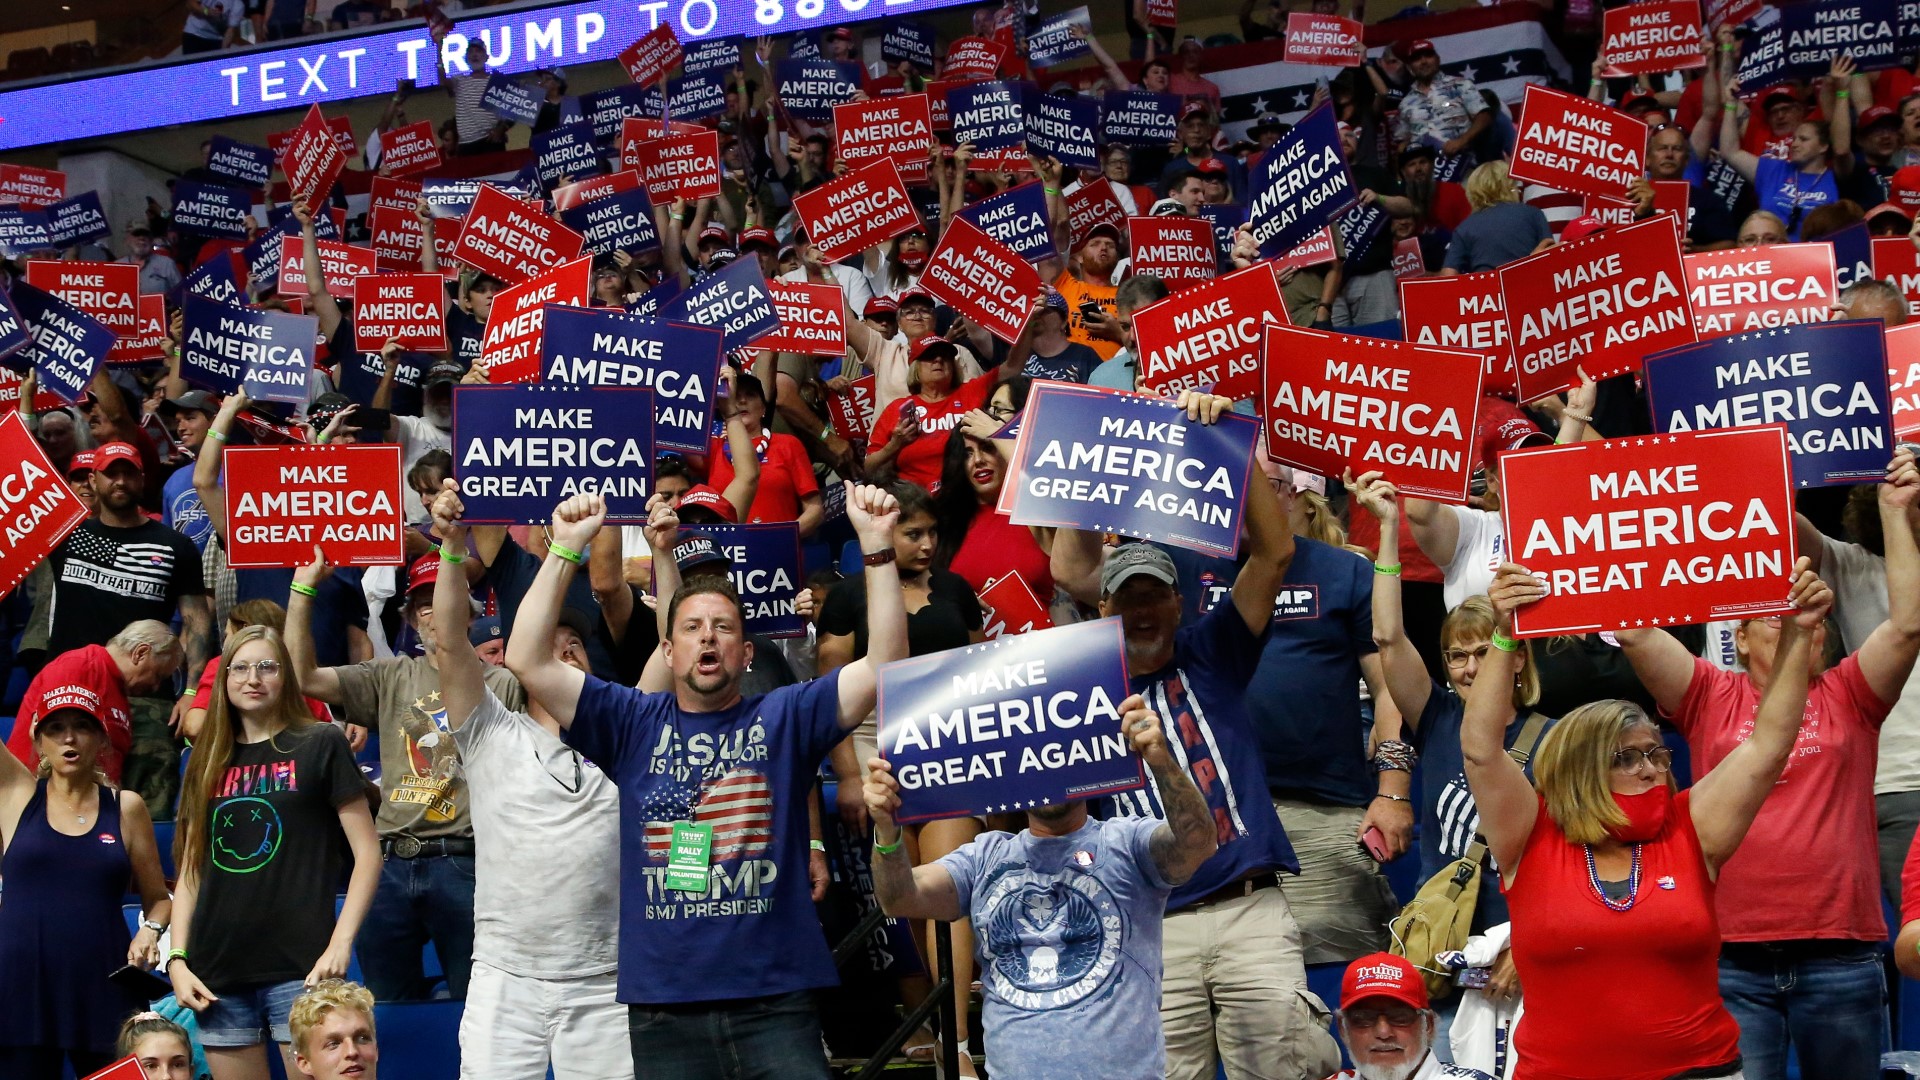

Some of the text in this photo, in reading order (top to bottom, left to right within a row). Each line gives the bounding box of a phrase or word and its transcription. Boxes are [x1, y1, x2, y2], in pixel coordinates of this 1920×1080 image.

[1311, 22, 1340, 32] MAKE
[1630, 11, 1671, 26] MAKE
[1815, 7, 1861, 24] MAKE
[636, 37, 659, 55] MAKE
[701, 40, 725, 50] MAKE
[1606, 24, 1699, 50] AMERICA
[221, 48, 366, 106] TEXT
[397, 12, 605, 79] TRUMP
[639, 1, 717, 36] TO
[684, 45, 739, 64] AMERICA
[802, 68, 836, 79] MAKE
[780, 80, 856, 96] AMERICA
[972, 91, 1010, 106] MAKE
[862, 108, 900, 123] MAKE
[1040, 104, 1071, 121] MAKE
[1128, 100, 1158, 110] MAKE
[1026, 114, 1094, 144] AMERICA
[1107, 110, 1176, 126] AMERICA
[1562, 110, 1612, 136] MAKE
[396, 132, 416, 144] MAKE
[549, 134, 574, 148] MAKE
[841, 120, 928, 145] AMERICA
[1027, 132, 1055, 153] GREAT
[386, 138, 434, 160] AMERICA
[659, 144, 694, 159] MAKE
[842, 139, 929, 160] GREAT AGAIN
[1524, 122, 1639, 170] AMERICA
[646, 156, 716, 181] AMERICA
[1268, 138, 1306, 180] MAKE
[1520, 146, 1638, 187] GREAT AGAIN
[827, 181, 868, 207] MAKE
[1250, 146, 1341, 219] AMERICA
[177, 200, 246, 220] AMERICA
[198, 191, 228, 204] MAKE
[1255, 171, 1348, 245] GREAT AGAIN
[587, 203, 622, 223] MAKE
[812, 186, 902, 238] AMERICA
[979, 203, 1016, 226] MAKE
[506, 211, 550, 240] MAKE
[817, 204, 910, 252] GREAT AGAIN
[1158, 229, 1192, 240] MAKE
[464, 235, 516, 266] GREAT
[973, 246, 1015, 278] MAKE
[1136, 244, 1214, 262] AMERICA
[61, 274, 104, 287] MAKE
[938, 246, 1028, 313] AMERICA
[1554, 254, 1622, 293] MAKE
[1697, 260, 1772, 280] MAKE
[379, 286, 414, 298] MAKE
[686, 281, 728, 311] MAKE
[768, 291, 810, 304] MAKE
[930, 266, 1021, 329] GREAT AGAIN
[358, 302, 440, 320] AMERICA
[724, 303, 772, 336] AGAIN
[1520, 271, 1679, 346] AMERICA
[1743, 306, 1829, 330] AGAIN
[220, 318, 273, 340] MAKE
[358, 324, 440, 338] GREAT AGAIN
[1522, 306, 1686, 374] GREAT AGAIN
[187, 326, 306, 368] AMERICA
[592, 333, 664, 360] MAKE
[187, 350, 240, 379] GREAT
[365, 353, 420, 379] TRMP
[1326, 359, 1410, 392] MAKE
[1716, 352, 1811, 388] MAKE
[547, 354, 705, 403] AMERICA
[516, 408, 592, 428] MAKE
[1273, 381, 1462, 440] AMERICA
[1668, 381, 1880, 432] AMERICA
[918, 413, 964, 433] UMP
[1100, 416, 1186, 446] MAKE
[1509, 428, 1531, 438] 2020
[463, 438, 645, 467] AMERICA
[1274, 419, 1461, 473] GREAT AGAIN
[1788, 426, 1884, 455] AGAIN
[280, 466, 347, 483] MAKE
[1034, 440, 1234, 499] AMERICA
[1589, 464, 1699, 500] MAKE
[462, 476, 646, 497] GREAT AGAIN
[5, 482, 66, 548] AGAIN
[236, 491, 394, 518] AMERICA
[1029, 477, 1232, 528] GREAT AGAIN
[235, 524, 395, 543] GREAT AGAIN
[1522, 498, 1780, 559] AMERICA
[673, 540, 712, 560] TRUMP
[62, 564, 166, 597] BUILD THAT WALL
[1534, 549, 1782, 598] GREAT AGAIN
[1209, 587, 1312, 605] TMP
[1720, 630, 1735, 666] AND
[953, 659, 1047, 698] MAKE
[43, 684, 100, 705] MAKE AMERICA
[47, 696, 95, 712] GREAT AGAIN
[894, 685, 1120, 755] AMERICA
[898, 733, 1126, 790] GREAT AGAIN
[1800, 746, 1821, 756] you
[649, 757, 692, 782] IS MY
[395, 790, 453, 814] DON'T RUN
[678, 846, 702, 856] RALLY
[642, 860, 778, 903] TUMP
[670, 871, 704, 880] VOLUNTEER
[646, 898, 774, 920] IS MY PRESIDENT
[1357, 966, 1403, 980] Trump
